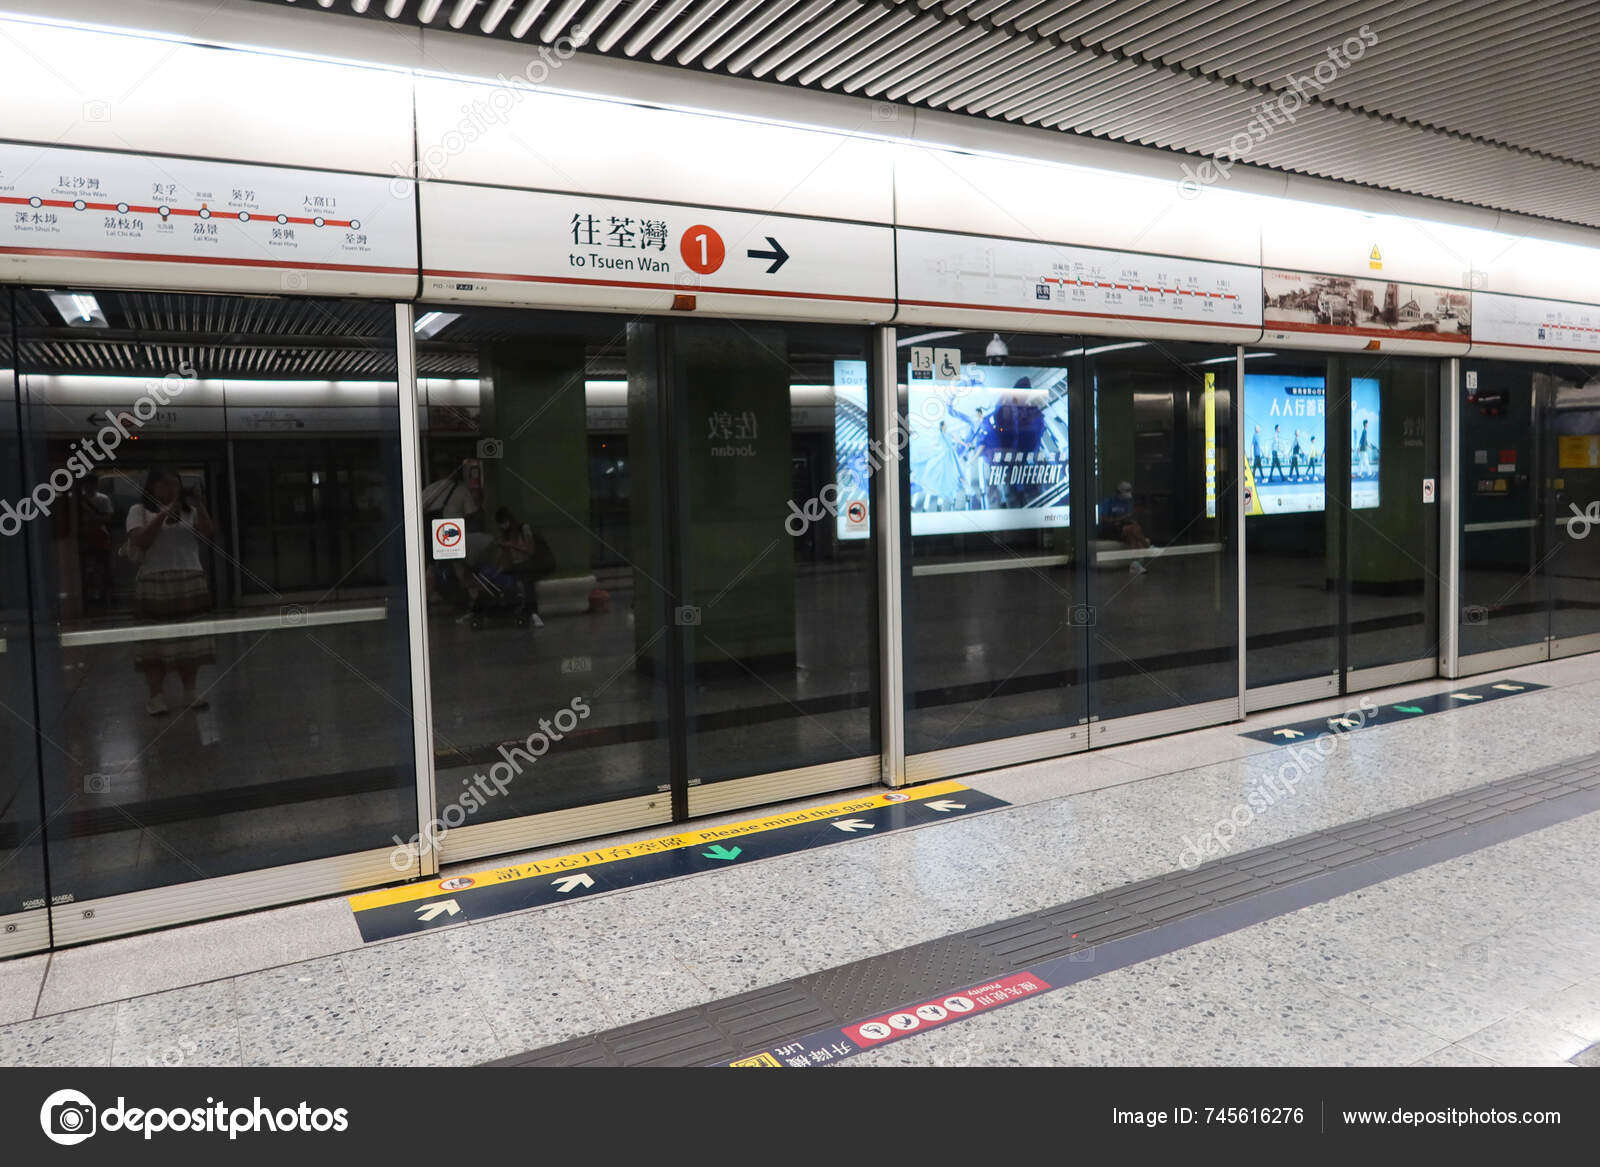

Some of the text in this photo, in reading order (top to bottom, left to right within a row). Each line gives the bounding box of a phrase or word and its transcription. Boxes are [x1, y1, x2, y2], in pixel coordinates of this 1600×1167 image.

[570, 213, 669, 252] 往荃灣
[695, 233, 708, 266] 1
[569, 253, 670, 273] to Tsuen Wan
[914, 350, 930, 369] 1-3
[989, 465, 1009, 486] THE
[1010, 464, 1063, 486] DIFFERENT
[699, 800, 875, 841] Please mind the gap
[496, 835, 687, 881] 請小心月台空隙
[967, 983, 1002, 996] Priority
[976, 981, 1038, 1006] 優先使用
[774, 1042, 805, 1056] Lift
